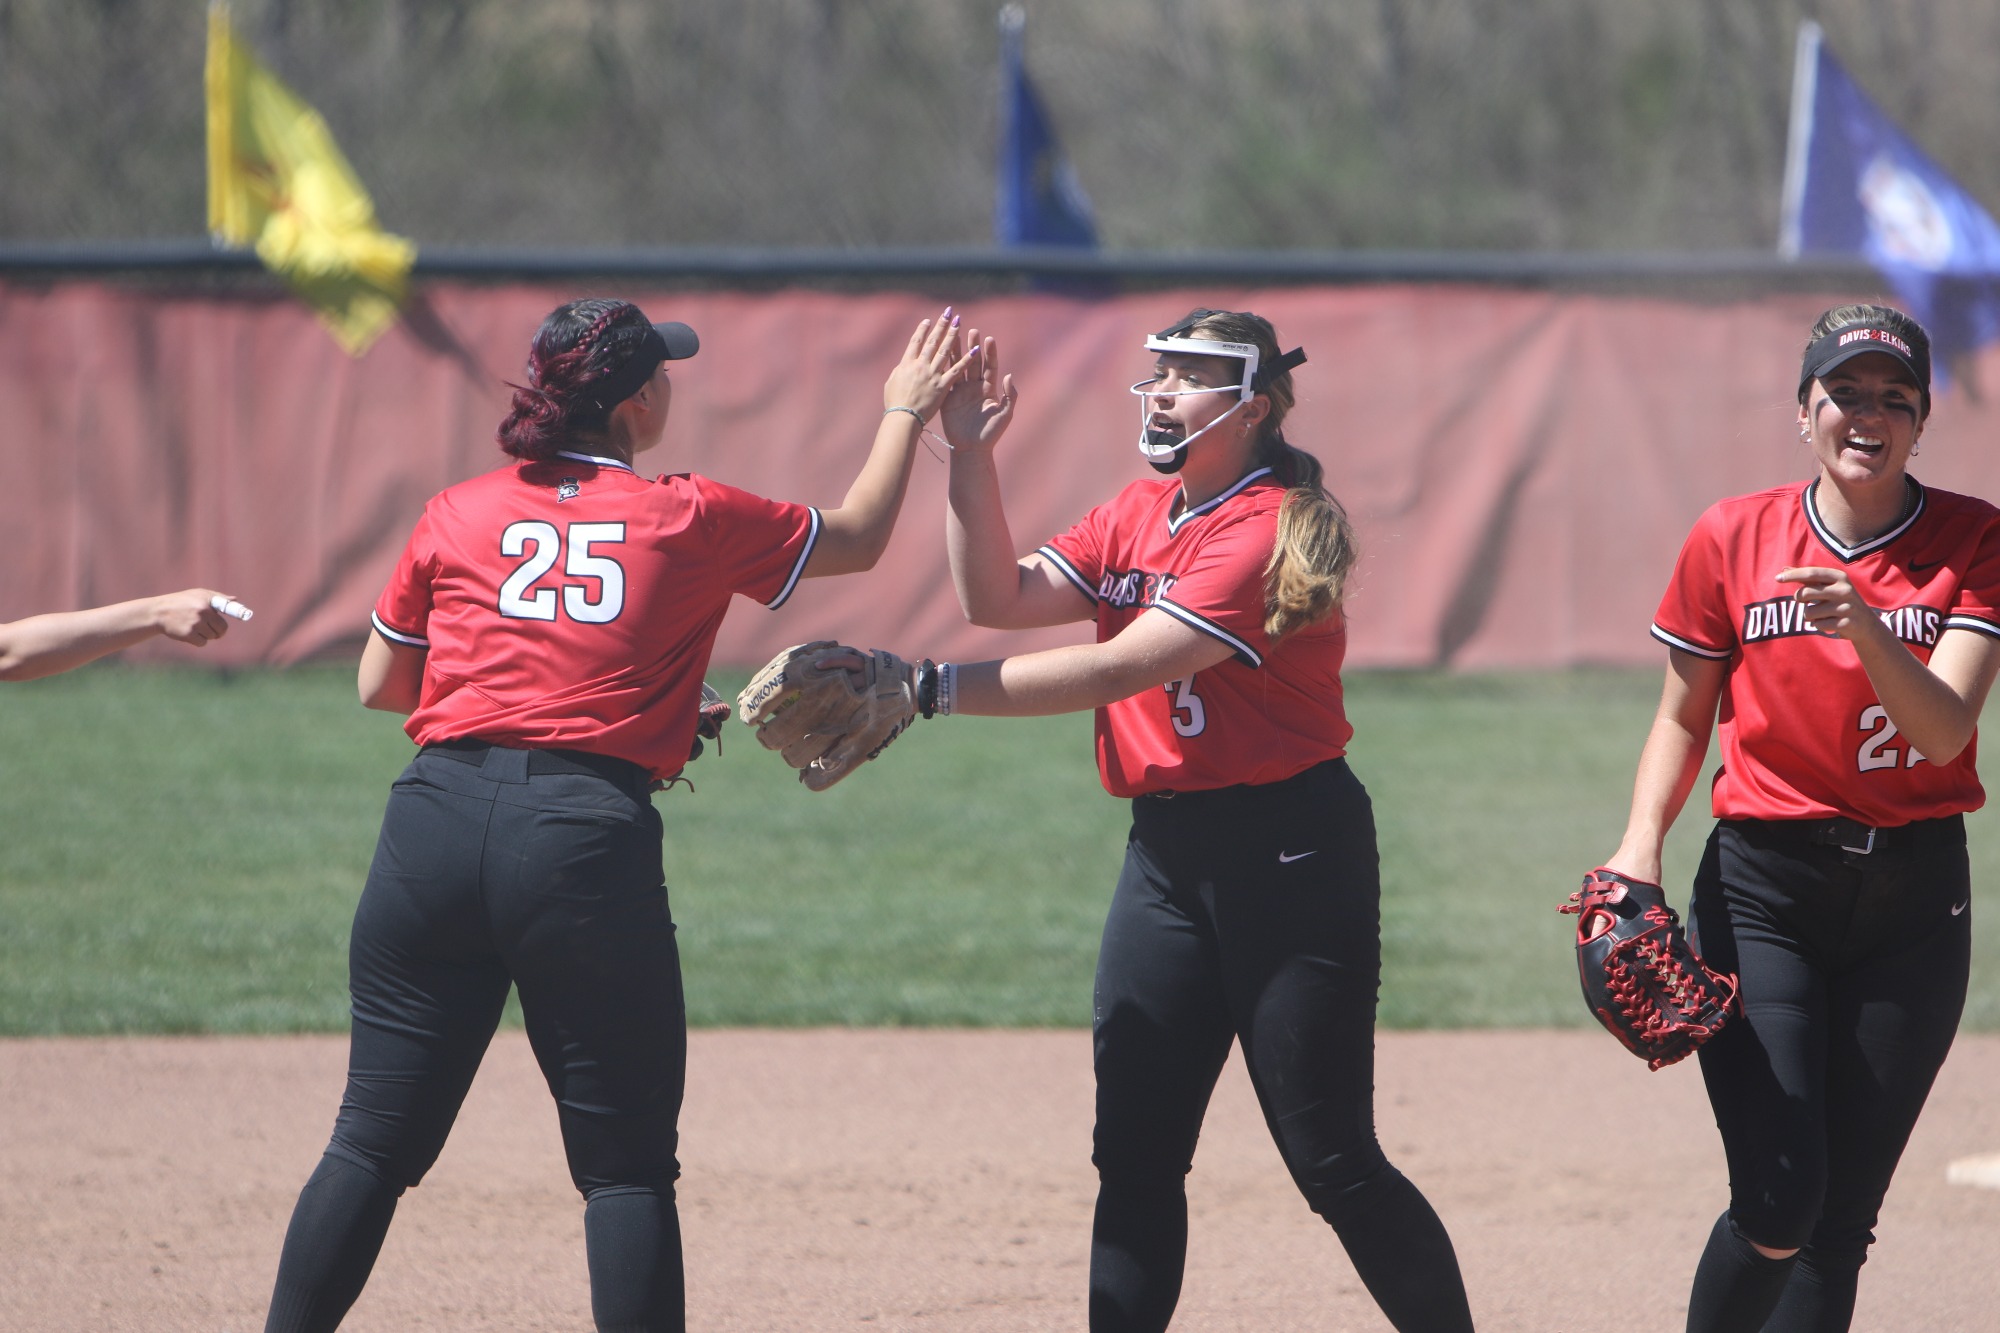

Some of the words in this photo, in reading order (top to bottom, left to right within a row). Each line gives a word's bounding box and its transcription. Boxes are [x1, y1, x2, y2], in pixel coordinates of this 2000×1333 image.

[498, 519, 626, 624] 25
[1163, 672, 1207, 738] 3
[1857, 704, 1928, 773] 2
